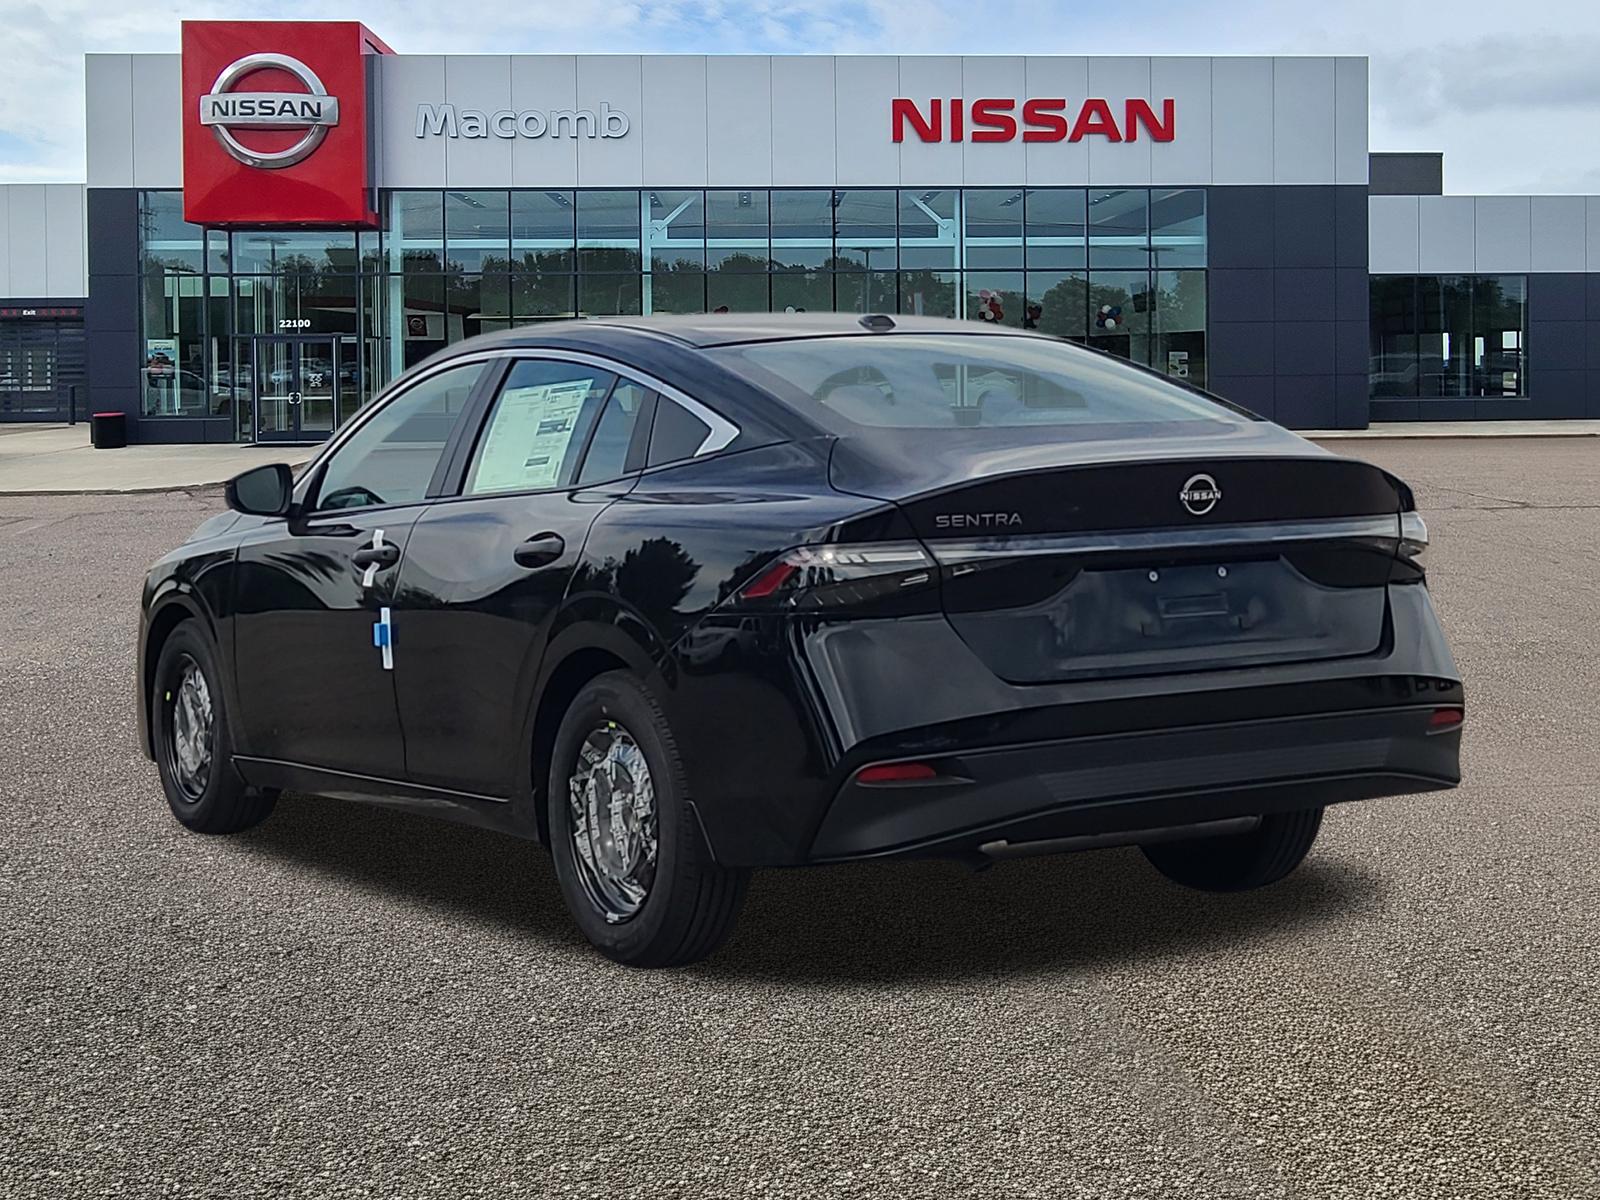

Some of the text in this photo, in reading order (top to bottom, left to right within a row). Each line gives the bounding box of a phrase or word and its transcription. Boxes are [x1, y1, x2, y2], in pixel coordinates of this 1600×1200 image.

[211, 100, 322, 118] NISSAN
[415, 101, 630, 139] Macomb
[891, 98, 1176, 143] NISSAN
[278, 319, 311, 328] 22100
[1179, 490, 1222, 501] NISSAN
[935, 512, 1023, 528] SENTRA
